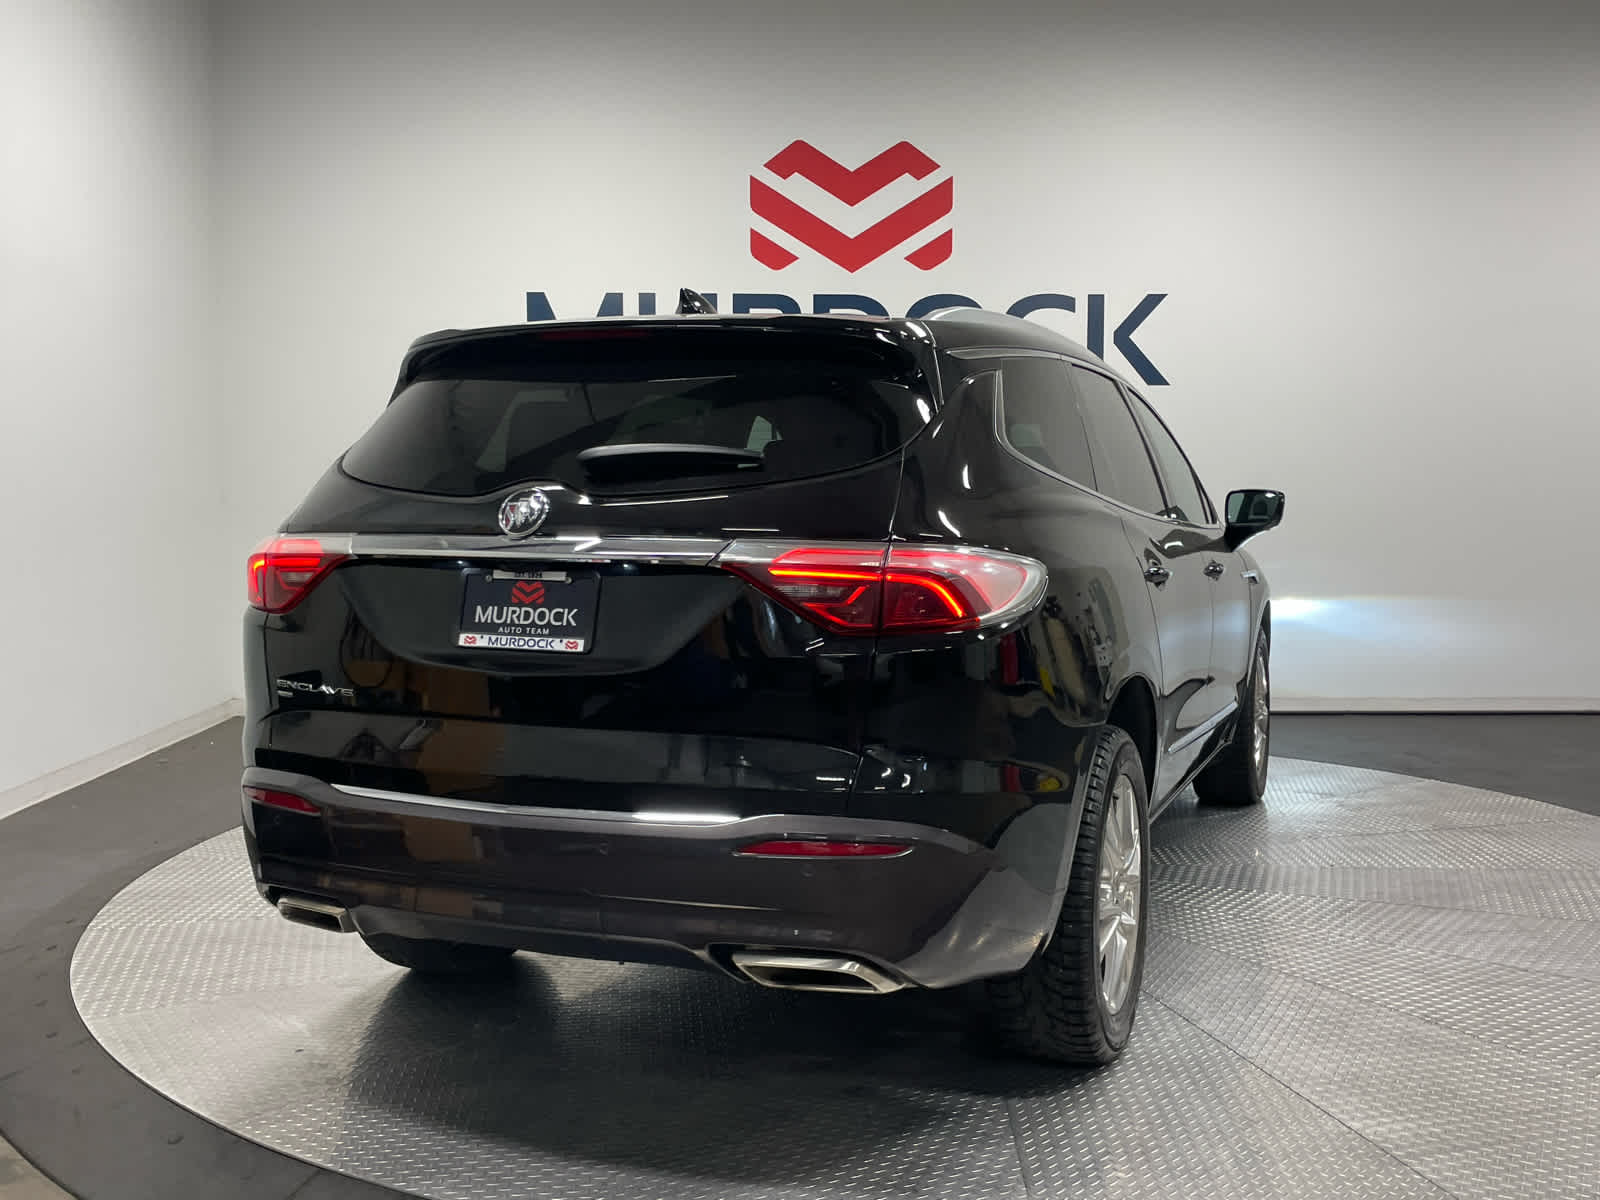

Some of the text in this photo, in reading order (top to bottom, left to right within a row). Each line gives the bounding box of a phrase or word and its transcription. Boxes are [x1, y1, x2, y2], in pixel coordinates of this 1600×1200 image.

[475, 605, 578, 626] MURDOCK
[498, 626, 550, 635] AUTO TEAM
[487, 636, 554, 649] MURDOCK
